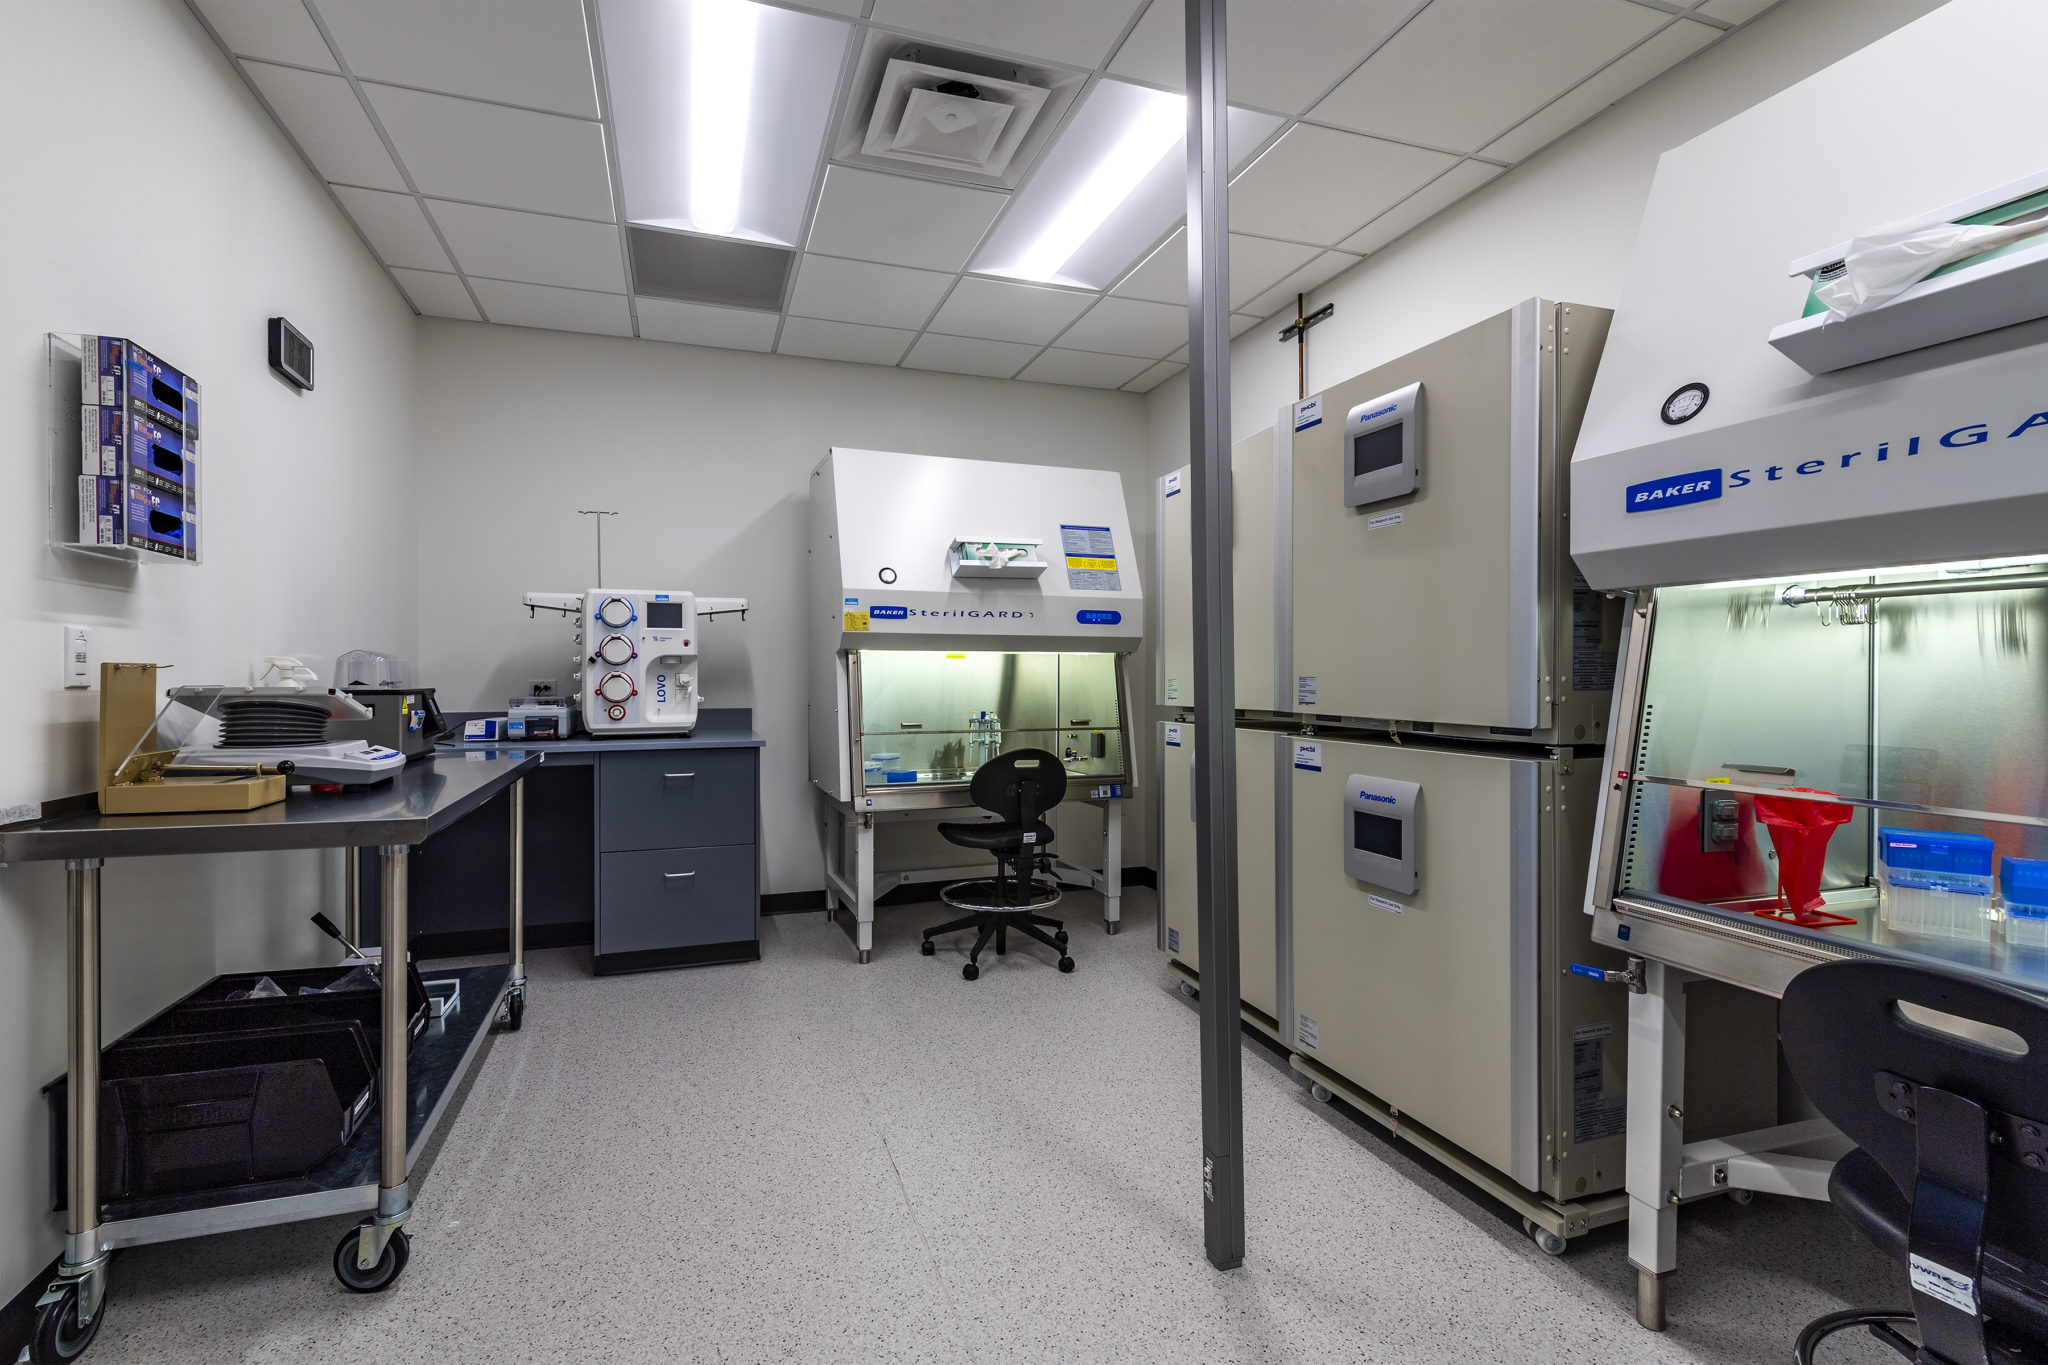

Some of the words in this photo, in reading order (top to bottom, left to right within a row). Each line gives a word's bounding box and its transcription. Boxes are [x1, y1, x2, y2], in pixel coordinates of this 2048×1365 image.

[1360, 403, 1398, 423] Panasonic
[1634, 480, 1712, 503] BAKER
[909, 608, 1023, 618] SterilGARD
[656, 674, 666, 703] LOVO
[1360, 790, 1397, 805] Panasonic
[1912, 1262, 1942, 1281] VWR
